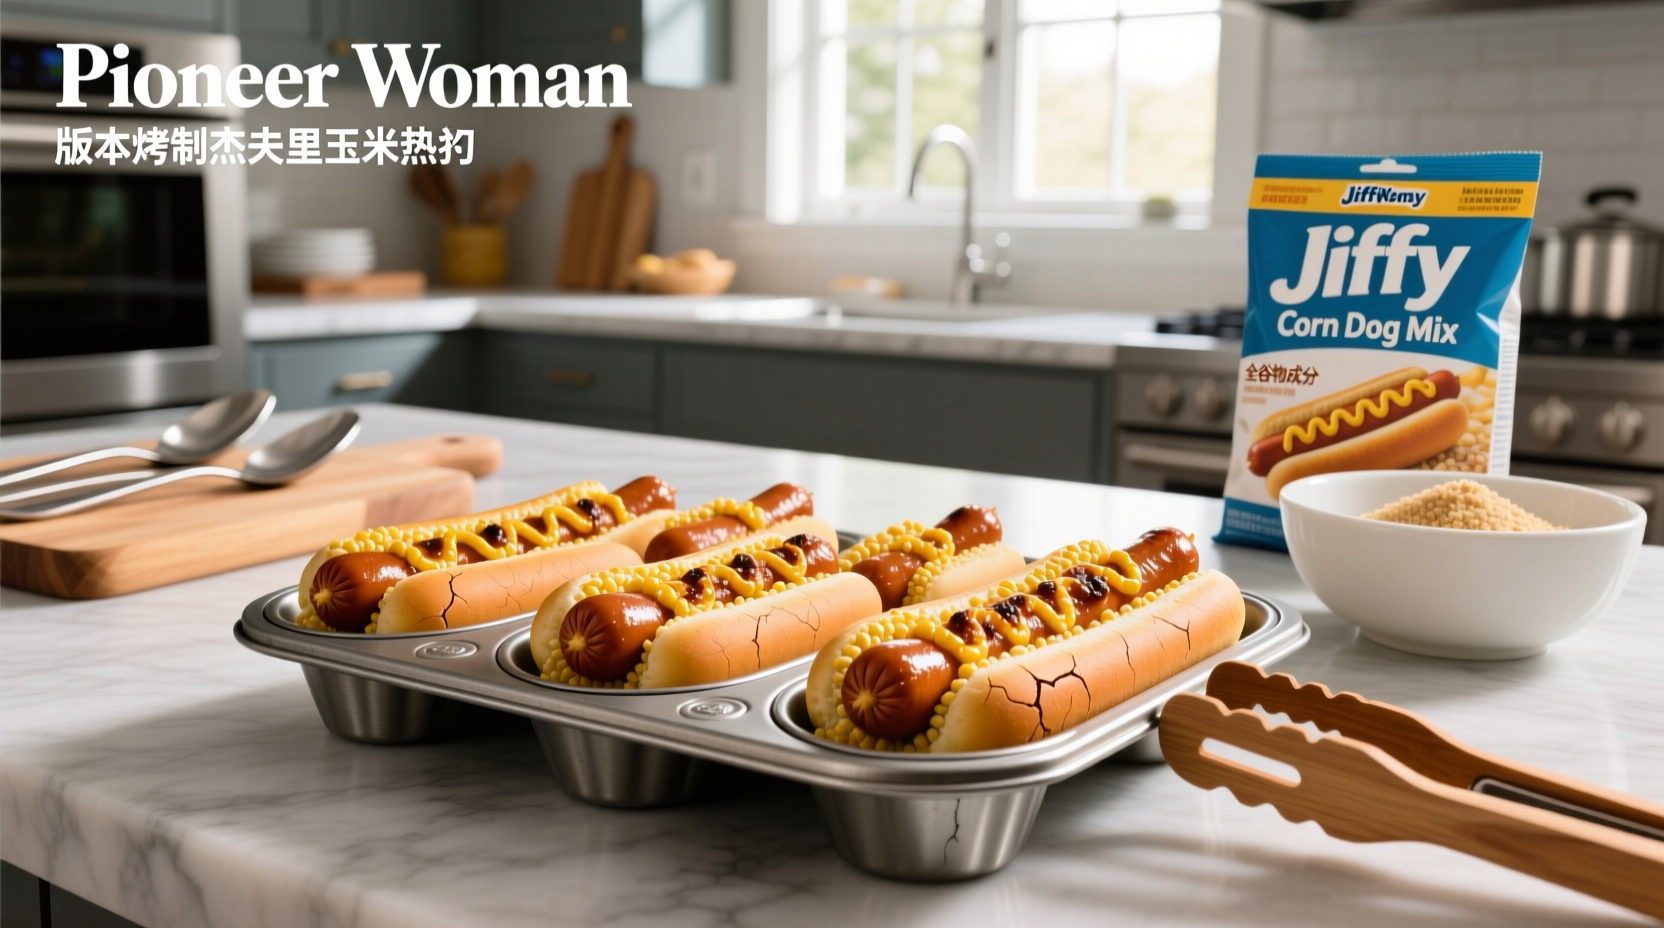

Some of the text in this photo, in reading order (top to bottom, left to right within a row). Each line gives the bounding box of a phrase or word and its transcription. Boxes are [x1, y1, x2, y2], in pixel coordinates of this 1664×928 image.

[1270, 222, 1472, 312] Jiffy
[1277, 309, 1459, 348] Corn Dog Mix
